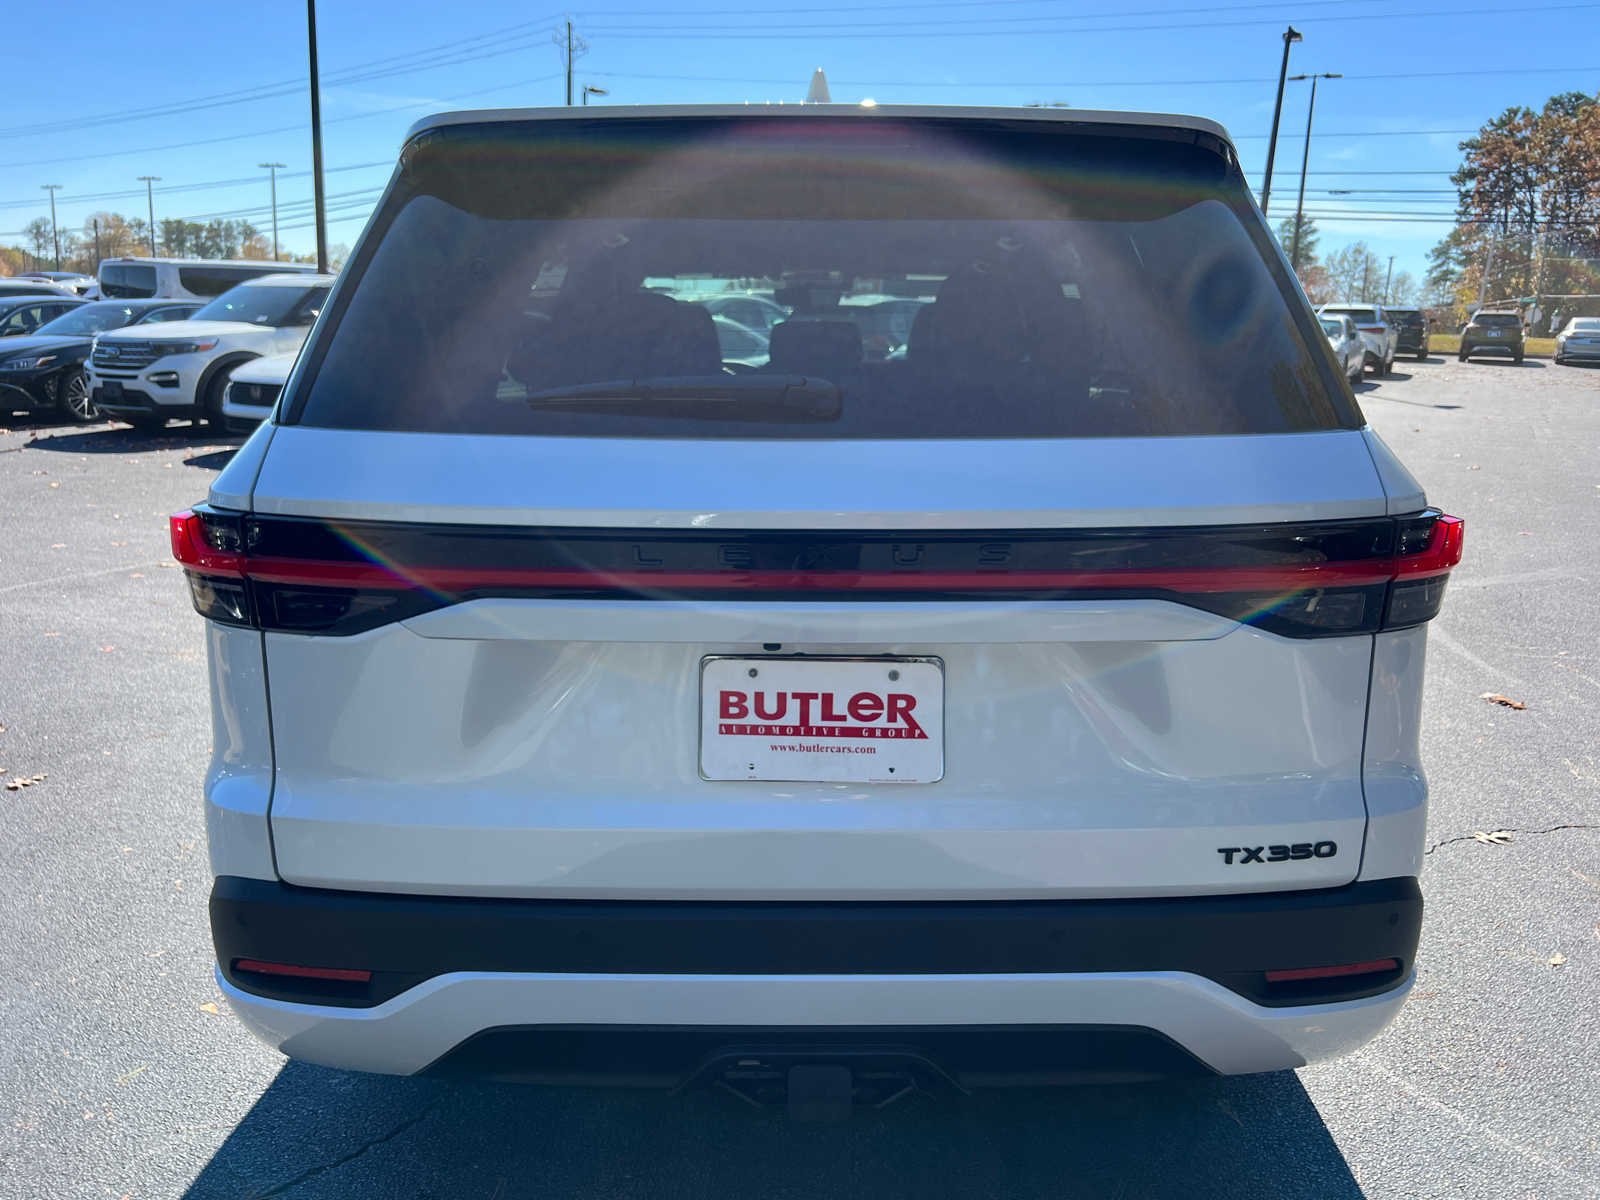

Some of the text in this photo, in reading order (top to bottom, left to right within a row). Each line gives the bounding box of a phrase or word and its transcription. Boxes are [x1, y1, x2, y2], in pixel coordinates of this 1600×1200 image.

[631, 543, 1012, 566] LEXUS
[719, 725, 922, 739] AUTOMOTIVE GROUP
[770, 743, 877, 755] www.butlercars.com
[1217, 840, 1338, 865] TX350
